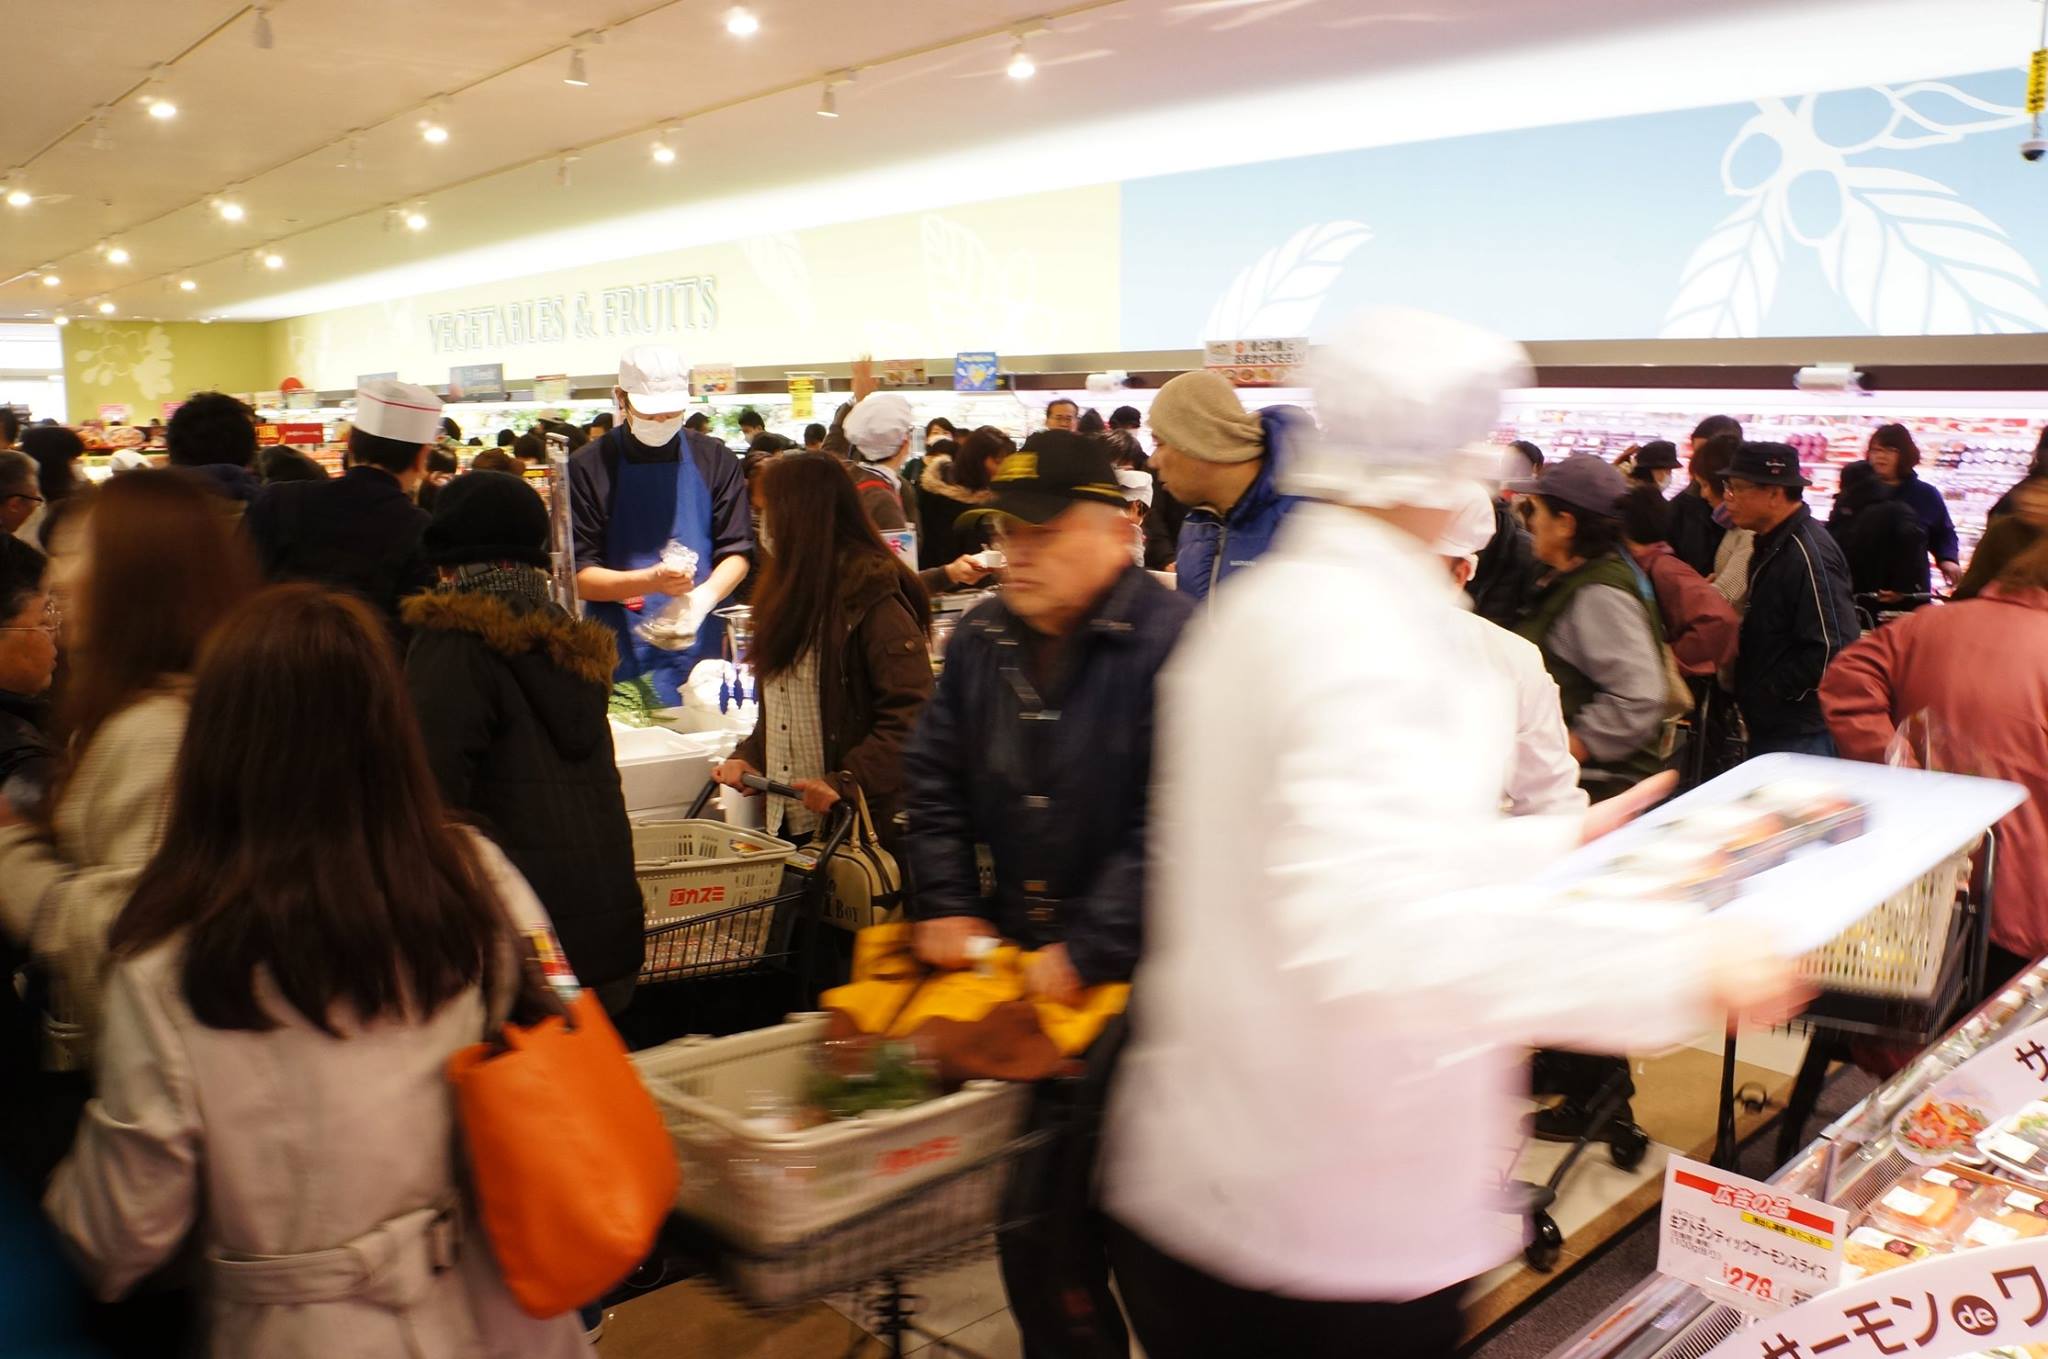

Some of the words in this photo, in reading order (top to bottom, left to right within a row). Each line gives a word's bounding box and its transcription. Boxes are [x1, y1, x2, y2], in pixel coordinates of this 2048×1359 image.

[428, 296, 566, 354] VEGETABLES
[573, 292, 599, 338] &
[601, 275, 718, 337] FRUITS
[1712, 1185, 1791, 1218] 広告の品
[1728, 1266, 1773, 1299] 278
